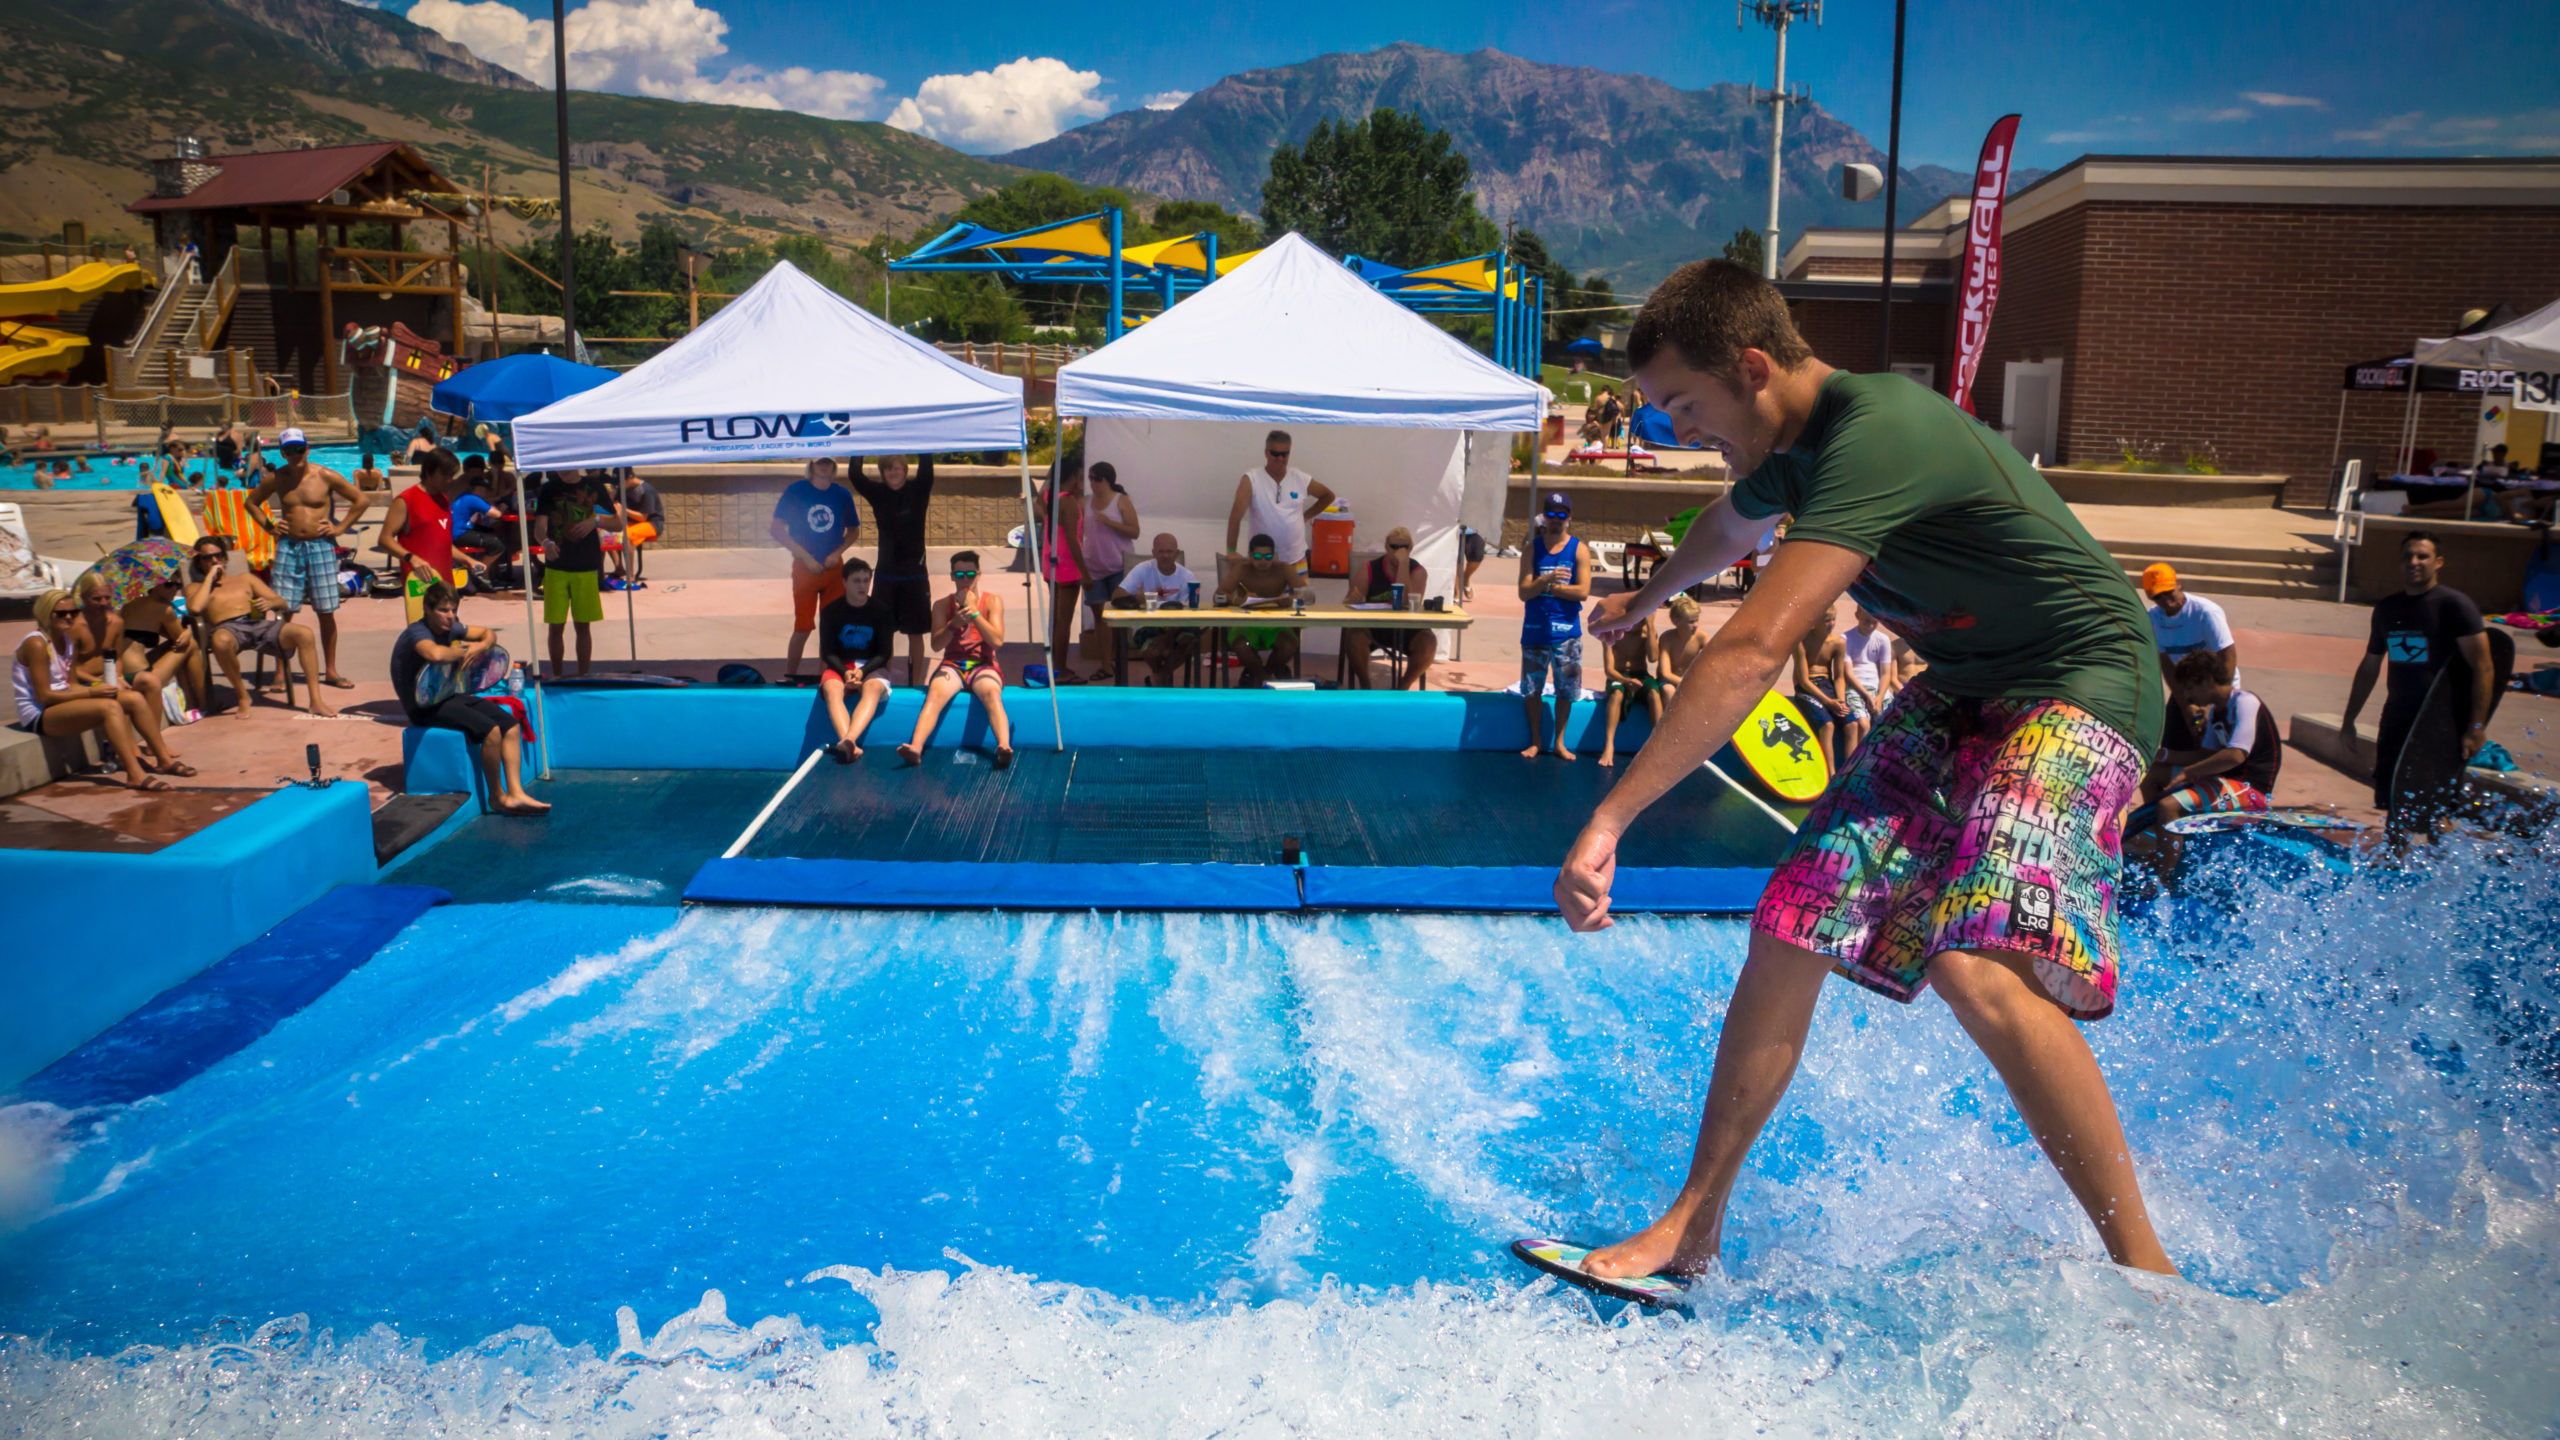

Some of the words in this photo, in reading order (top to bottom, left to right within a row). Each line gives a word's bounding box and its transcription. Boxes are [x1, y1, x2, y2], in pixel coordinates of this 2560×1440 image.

[681, 413, 806, 442] FLOW
[757, 442, 782, 450] LEAGUE
[807, 440, 832, 448] WORLD
